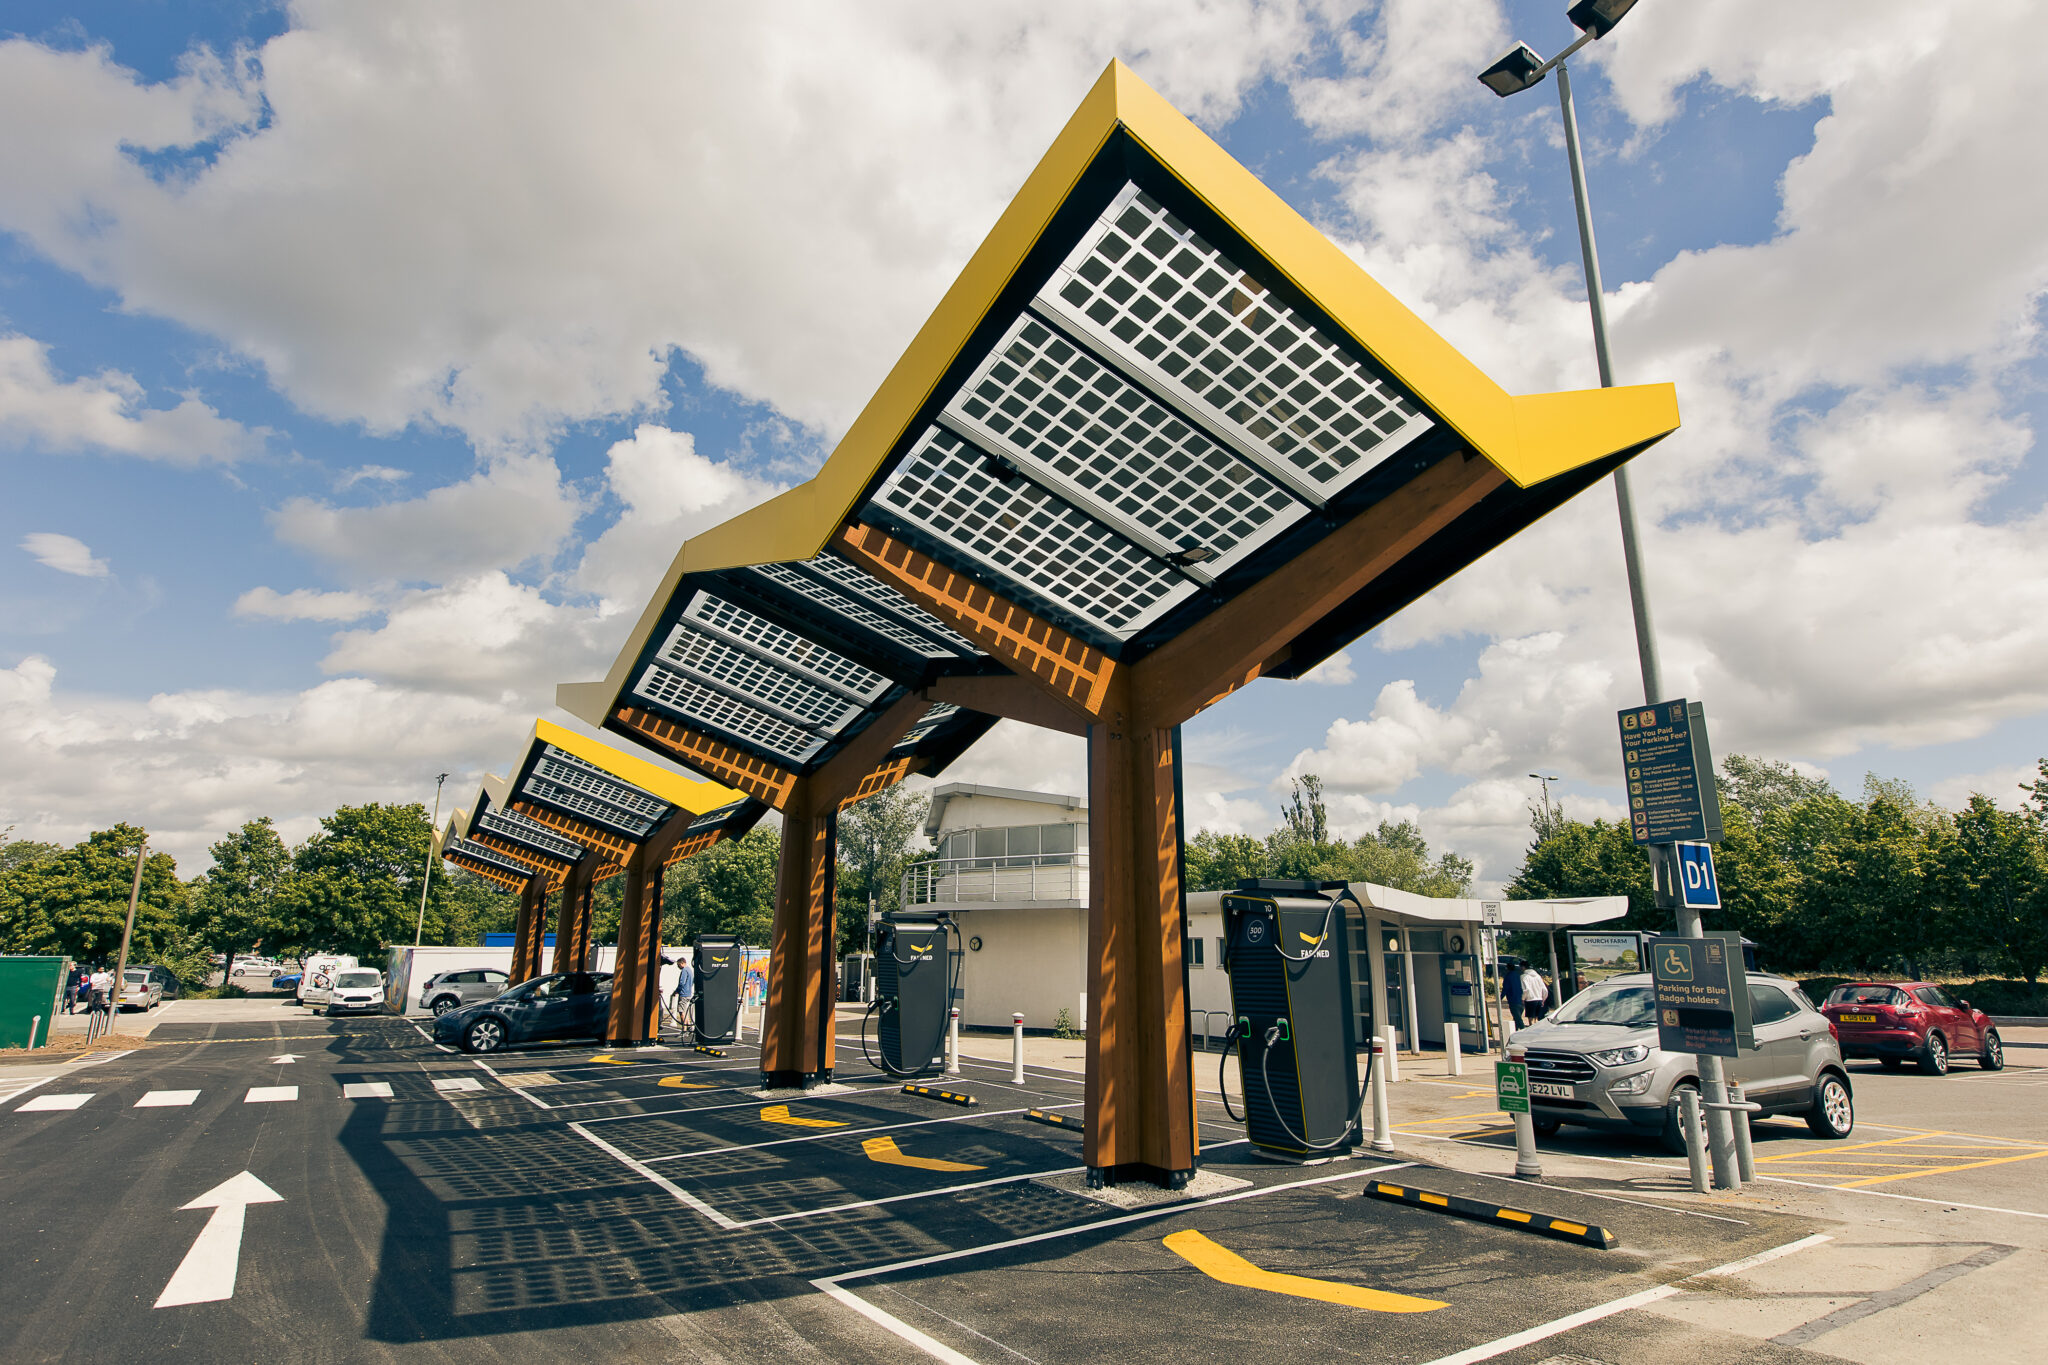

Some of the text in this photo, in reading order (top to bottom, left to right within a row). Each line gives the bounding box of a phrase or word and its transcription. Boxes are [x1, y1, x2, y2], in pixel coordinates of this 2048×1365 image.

[1624, 732, 1641, 740] Have
[1657, 726, 1673, 735] Paid
[1642, 736, 1670, 744] Parking
[1670, 731, 1687, 740] Fee?
[1686, 860, 1710, 890] D1
[1300, 949, 1330, 958] FASNED
[1658, 984, 1727, 995] Parking for Blue
[1659, 994, 1720, 1005] Badge holders
[1551, 1086, 1570, 1097] LVL
